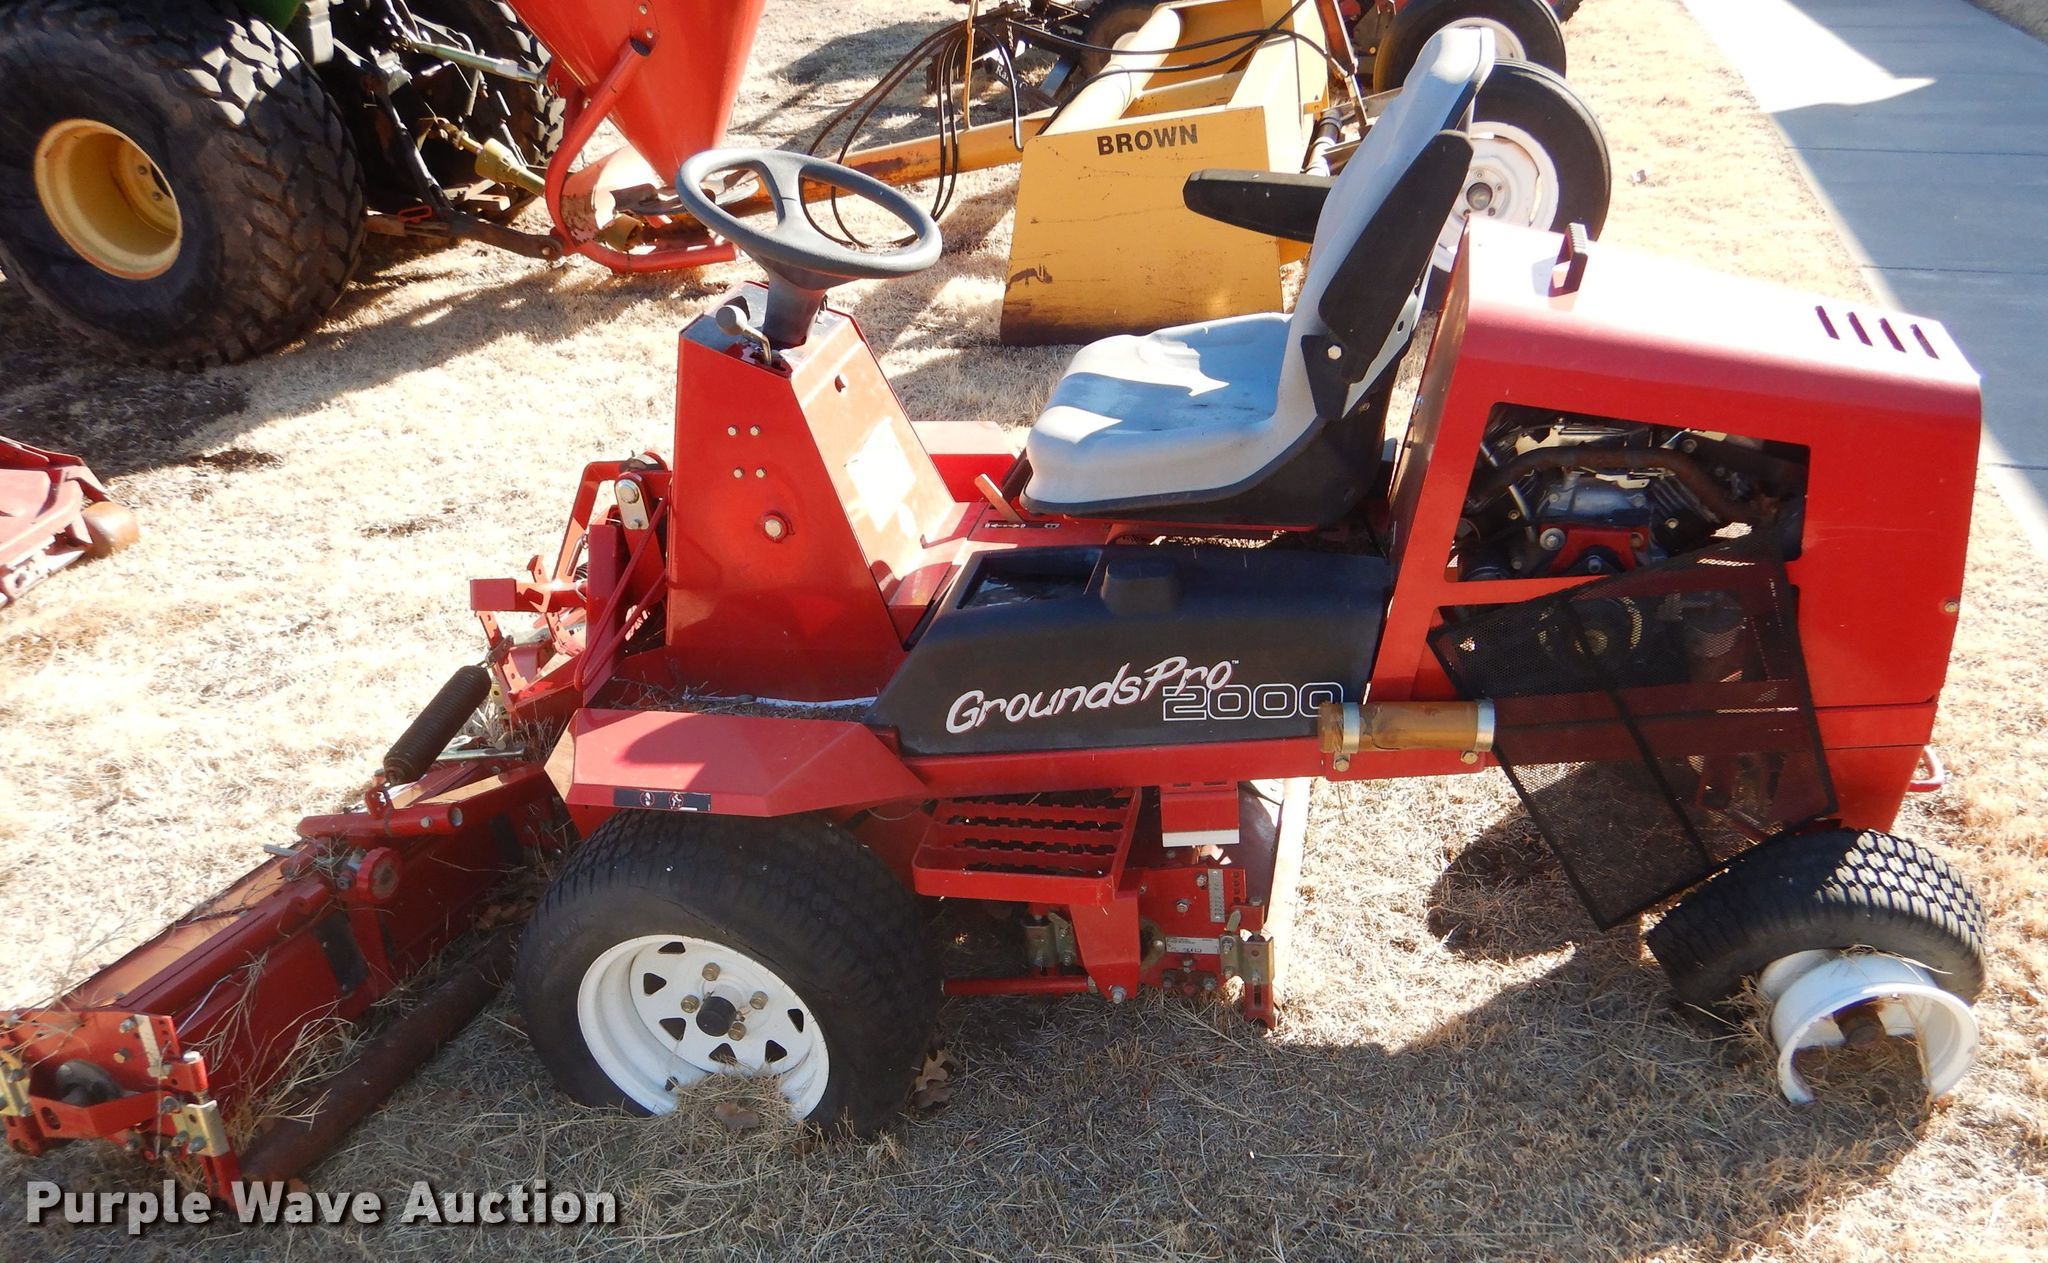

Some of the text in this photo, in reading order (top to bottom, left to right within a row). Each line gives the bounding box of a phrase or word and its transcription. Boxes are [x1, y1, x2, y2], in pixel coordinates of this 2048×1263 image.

[1097, 123, 1198, 156] BROWN
[945, 656, 1232, 735] GroundsPro
[1162, 682, 1344, 722] 2000
